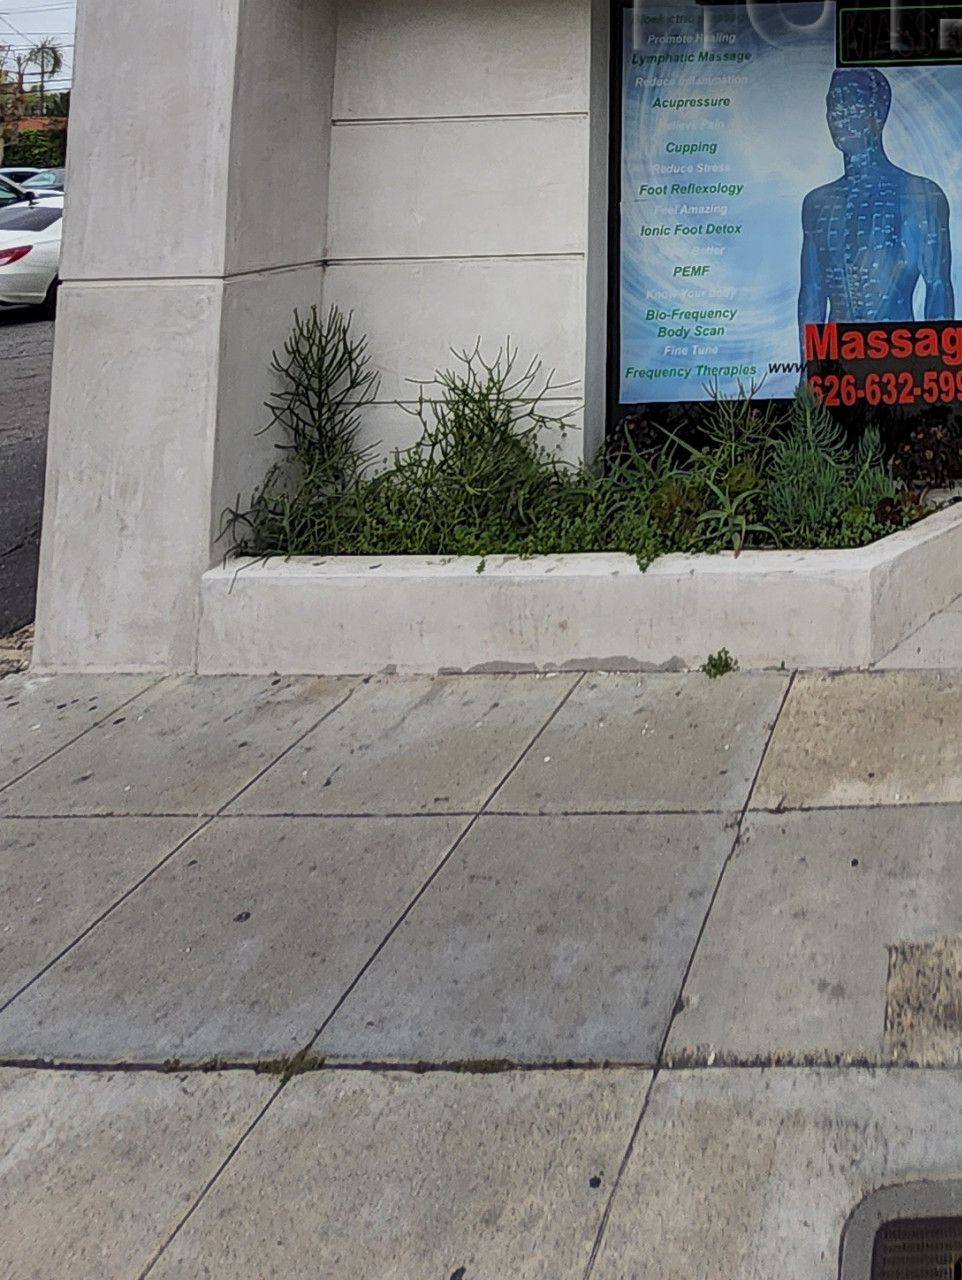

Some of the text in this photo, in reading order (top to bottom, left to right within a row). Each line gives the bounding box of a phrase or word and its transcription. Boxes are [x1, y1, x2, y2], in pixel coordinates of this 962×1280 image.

[647, 33, 693, 45] Promote
[631, 51, 752, 66] Lymphatic Massage
[634, 77, 676, 88] Reduce
[652, 96, 731, 110] Acupressure
[665, 141, 718, 155] Cupping
[652, 162, 731, 175] Reduce Stress
[639, 182, 744, 196] Foot Reflexology
[679, 204, 728, 217] Amazing
[640, 223, 742, 237] Ionic Foot Detox
[673, 266, 710, 277] PEMF
[681, 288, 706, 299] Your
[645, 309, 737, 321] Bio-Frequency
[657, 325, 725, 339] Body Scan
[663, 344, 719, 356] Fine Tune
[625, 364, 757, 380] Frequency Therapies
